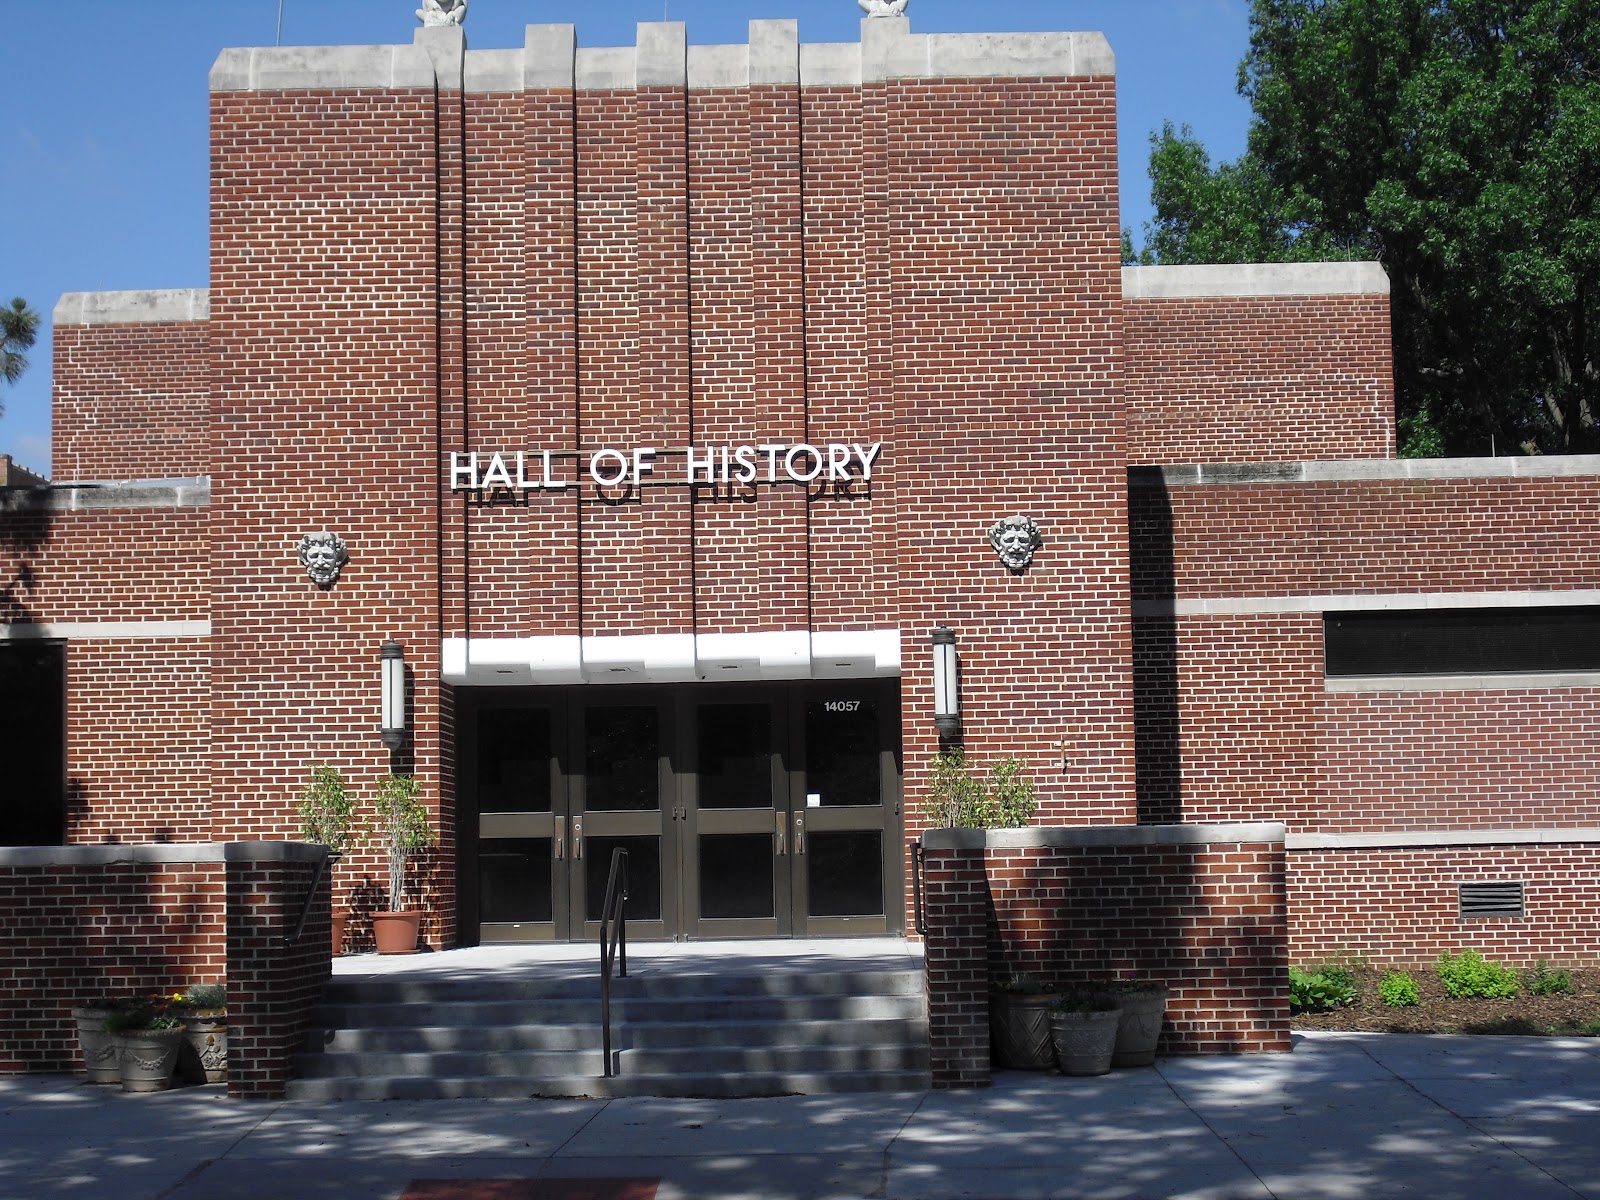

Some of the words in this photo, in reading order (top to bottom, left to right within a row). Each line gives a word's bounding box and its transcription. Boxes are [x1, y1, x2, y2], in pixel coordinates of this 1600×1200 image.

[450, 450, 566, 489] HALL
[590, 446, 656, 486] OF
[687, 442, 881, 484] HISTORY
[824, 700, 861, 712] 14057
